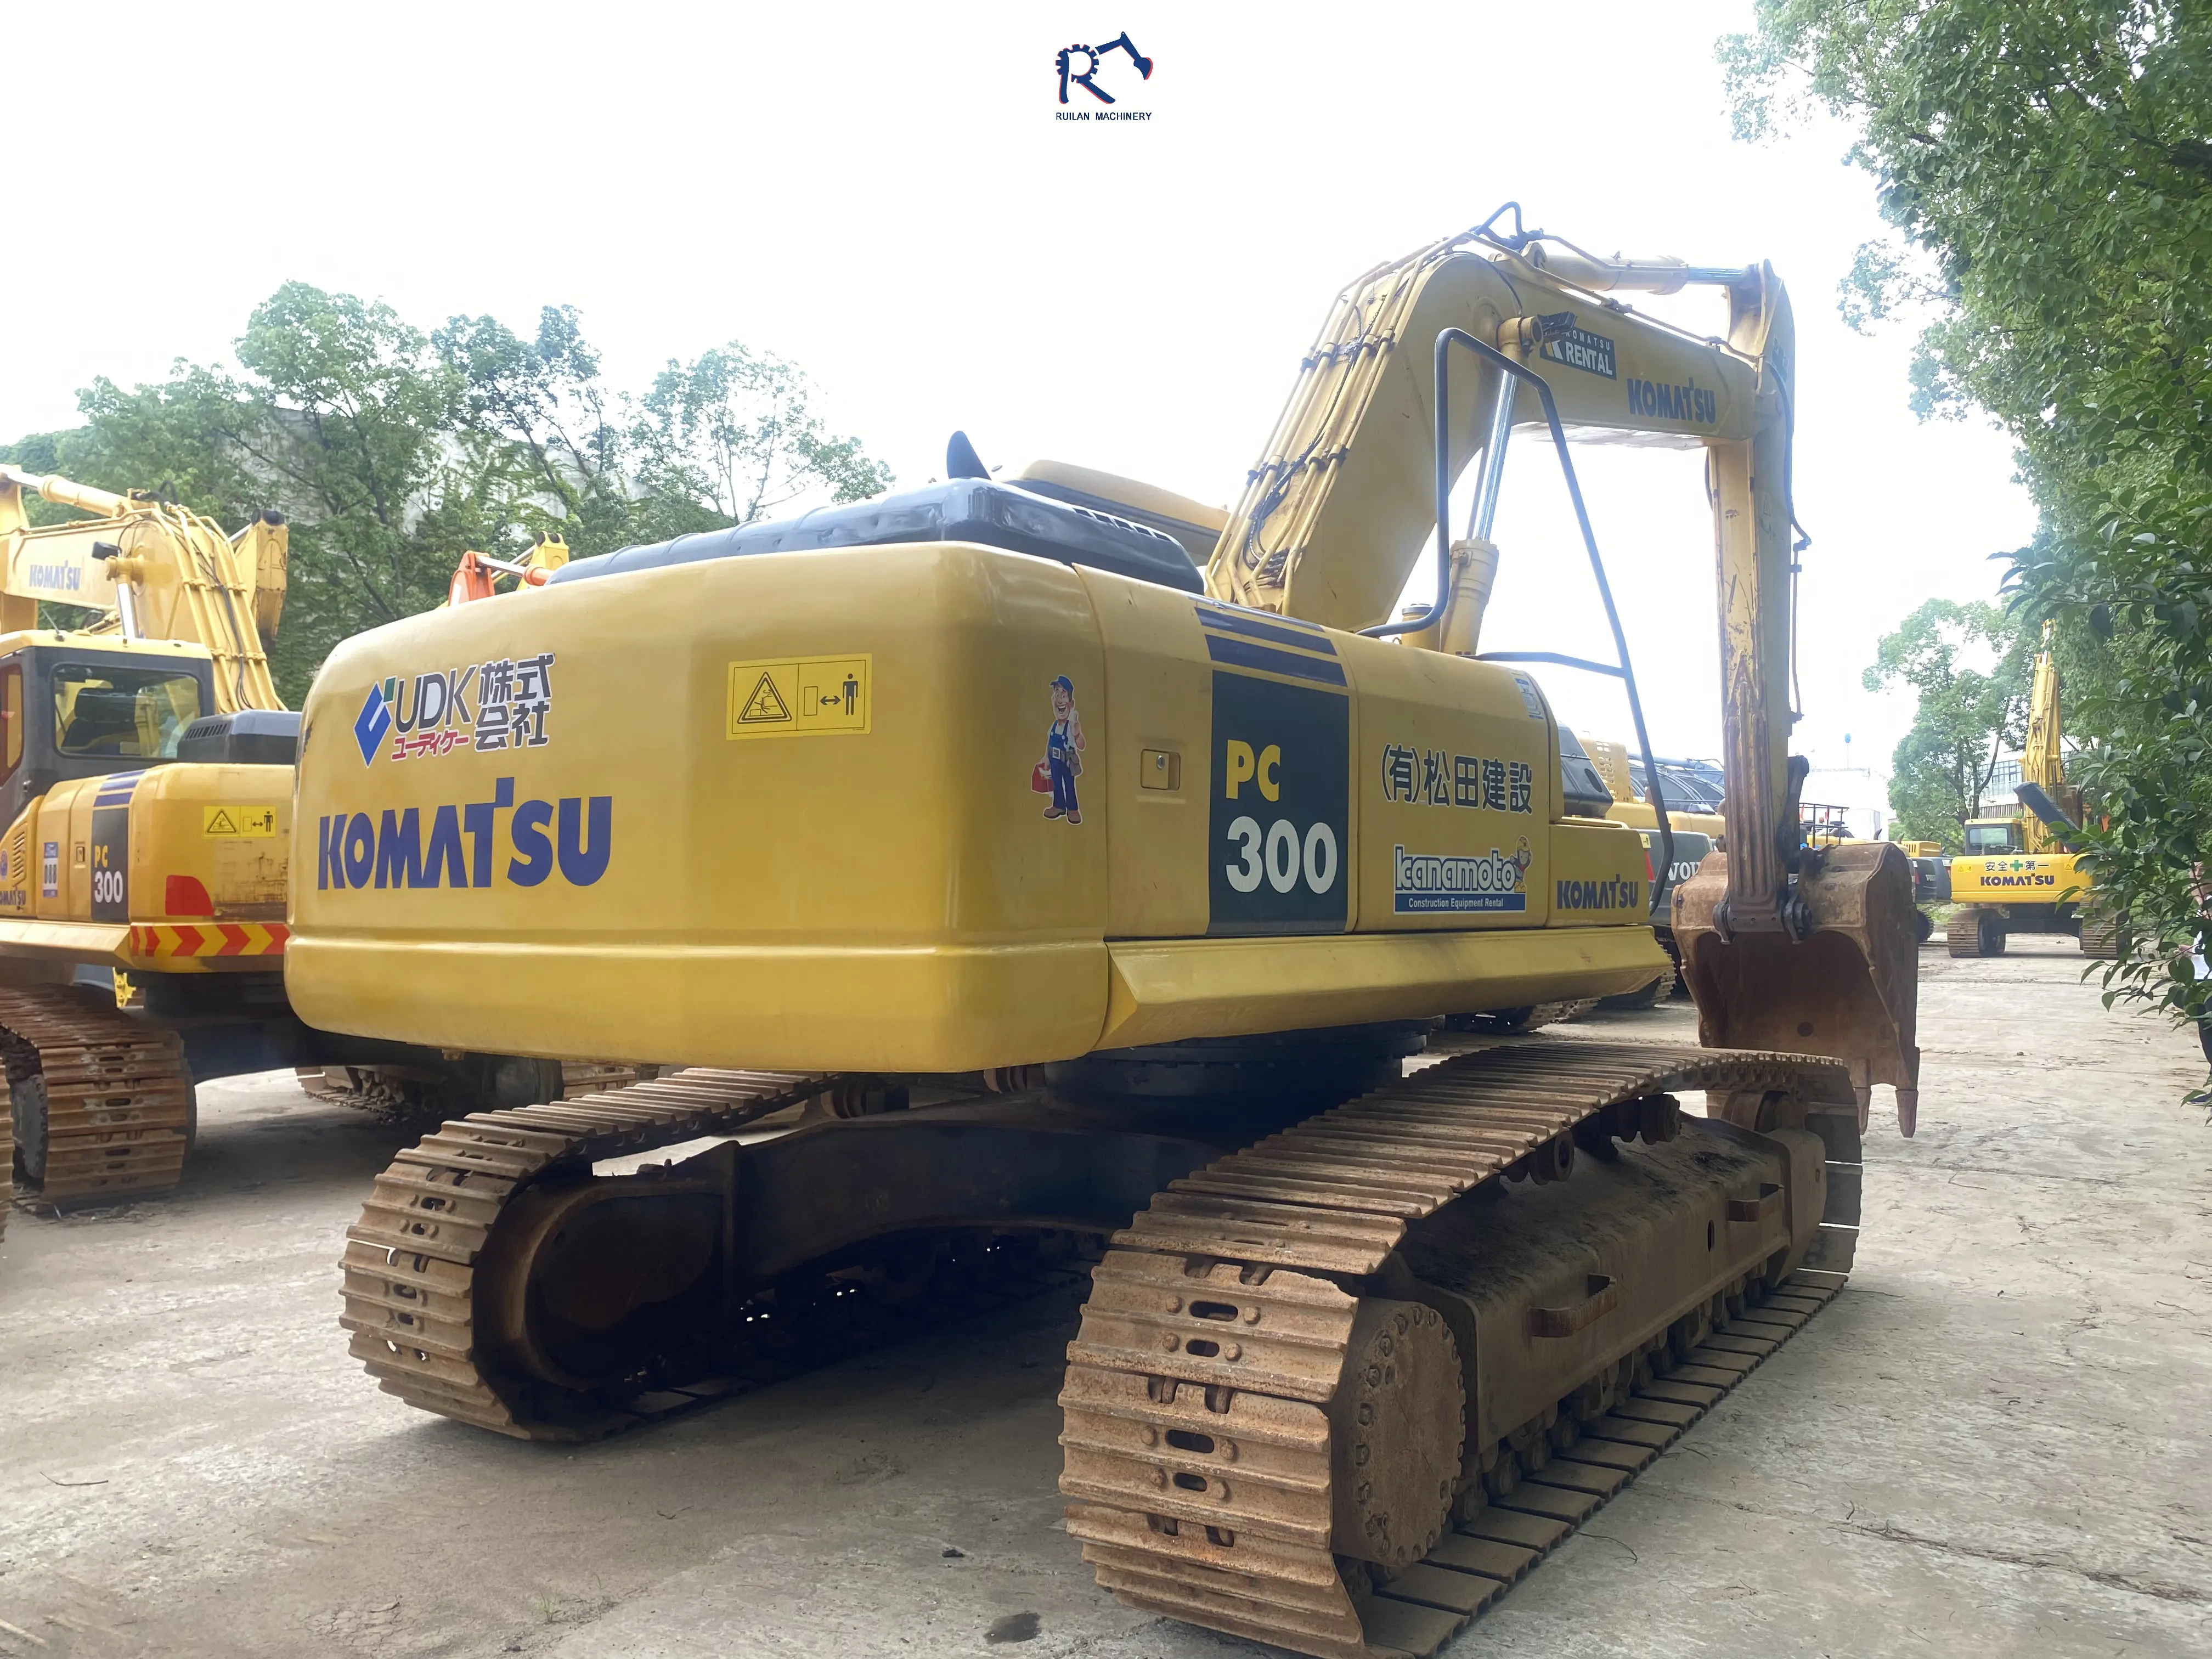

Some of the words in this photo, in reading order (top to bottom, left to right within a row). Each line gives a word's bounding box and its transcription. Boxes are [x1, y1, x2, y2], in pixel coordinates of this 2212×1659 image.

[1565, 341, 1613, 375] RENTAL
[1627, 377, 1716, 425] KOMATSU
[29, 560, 81, 591] KOMATSU
[396, 665, 477, 733] UDK
[477, 654, 555, 706] 株式
[475, 701, 550, 751] 会社
[1226, 740, 1281, 802] PC
[1381, 744, 1532, 815] (有)松田建設
[318, 776, 612, 890] KOMATSU
[1226, 816, 1338, 894] 300
[94, 845, 108, 868] PC
[1395, 846, 1516, 891] kanamoto
[1985, 861, 2007, 871] 安全
[2025, 861, 2050, 871] 第一
[94, 871, 123, 904] 300
[1557, 873, 1639, 909] KOMATSU
[1980, 873, 2055, 887] KOMATSU
[1408, 898, 1449, 908] Construction
[1451, 898, 1483, 909] Equipment
[1485, 898, 1504, 907] Rental
